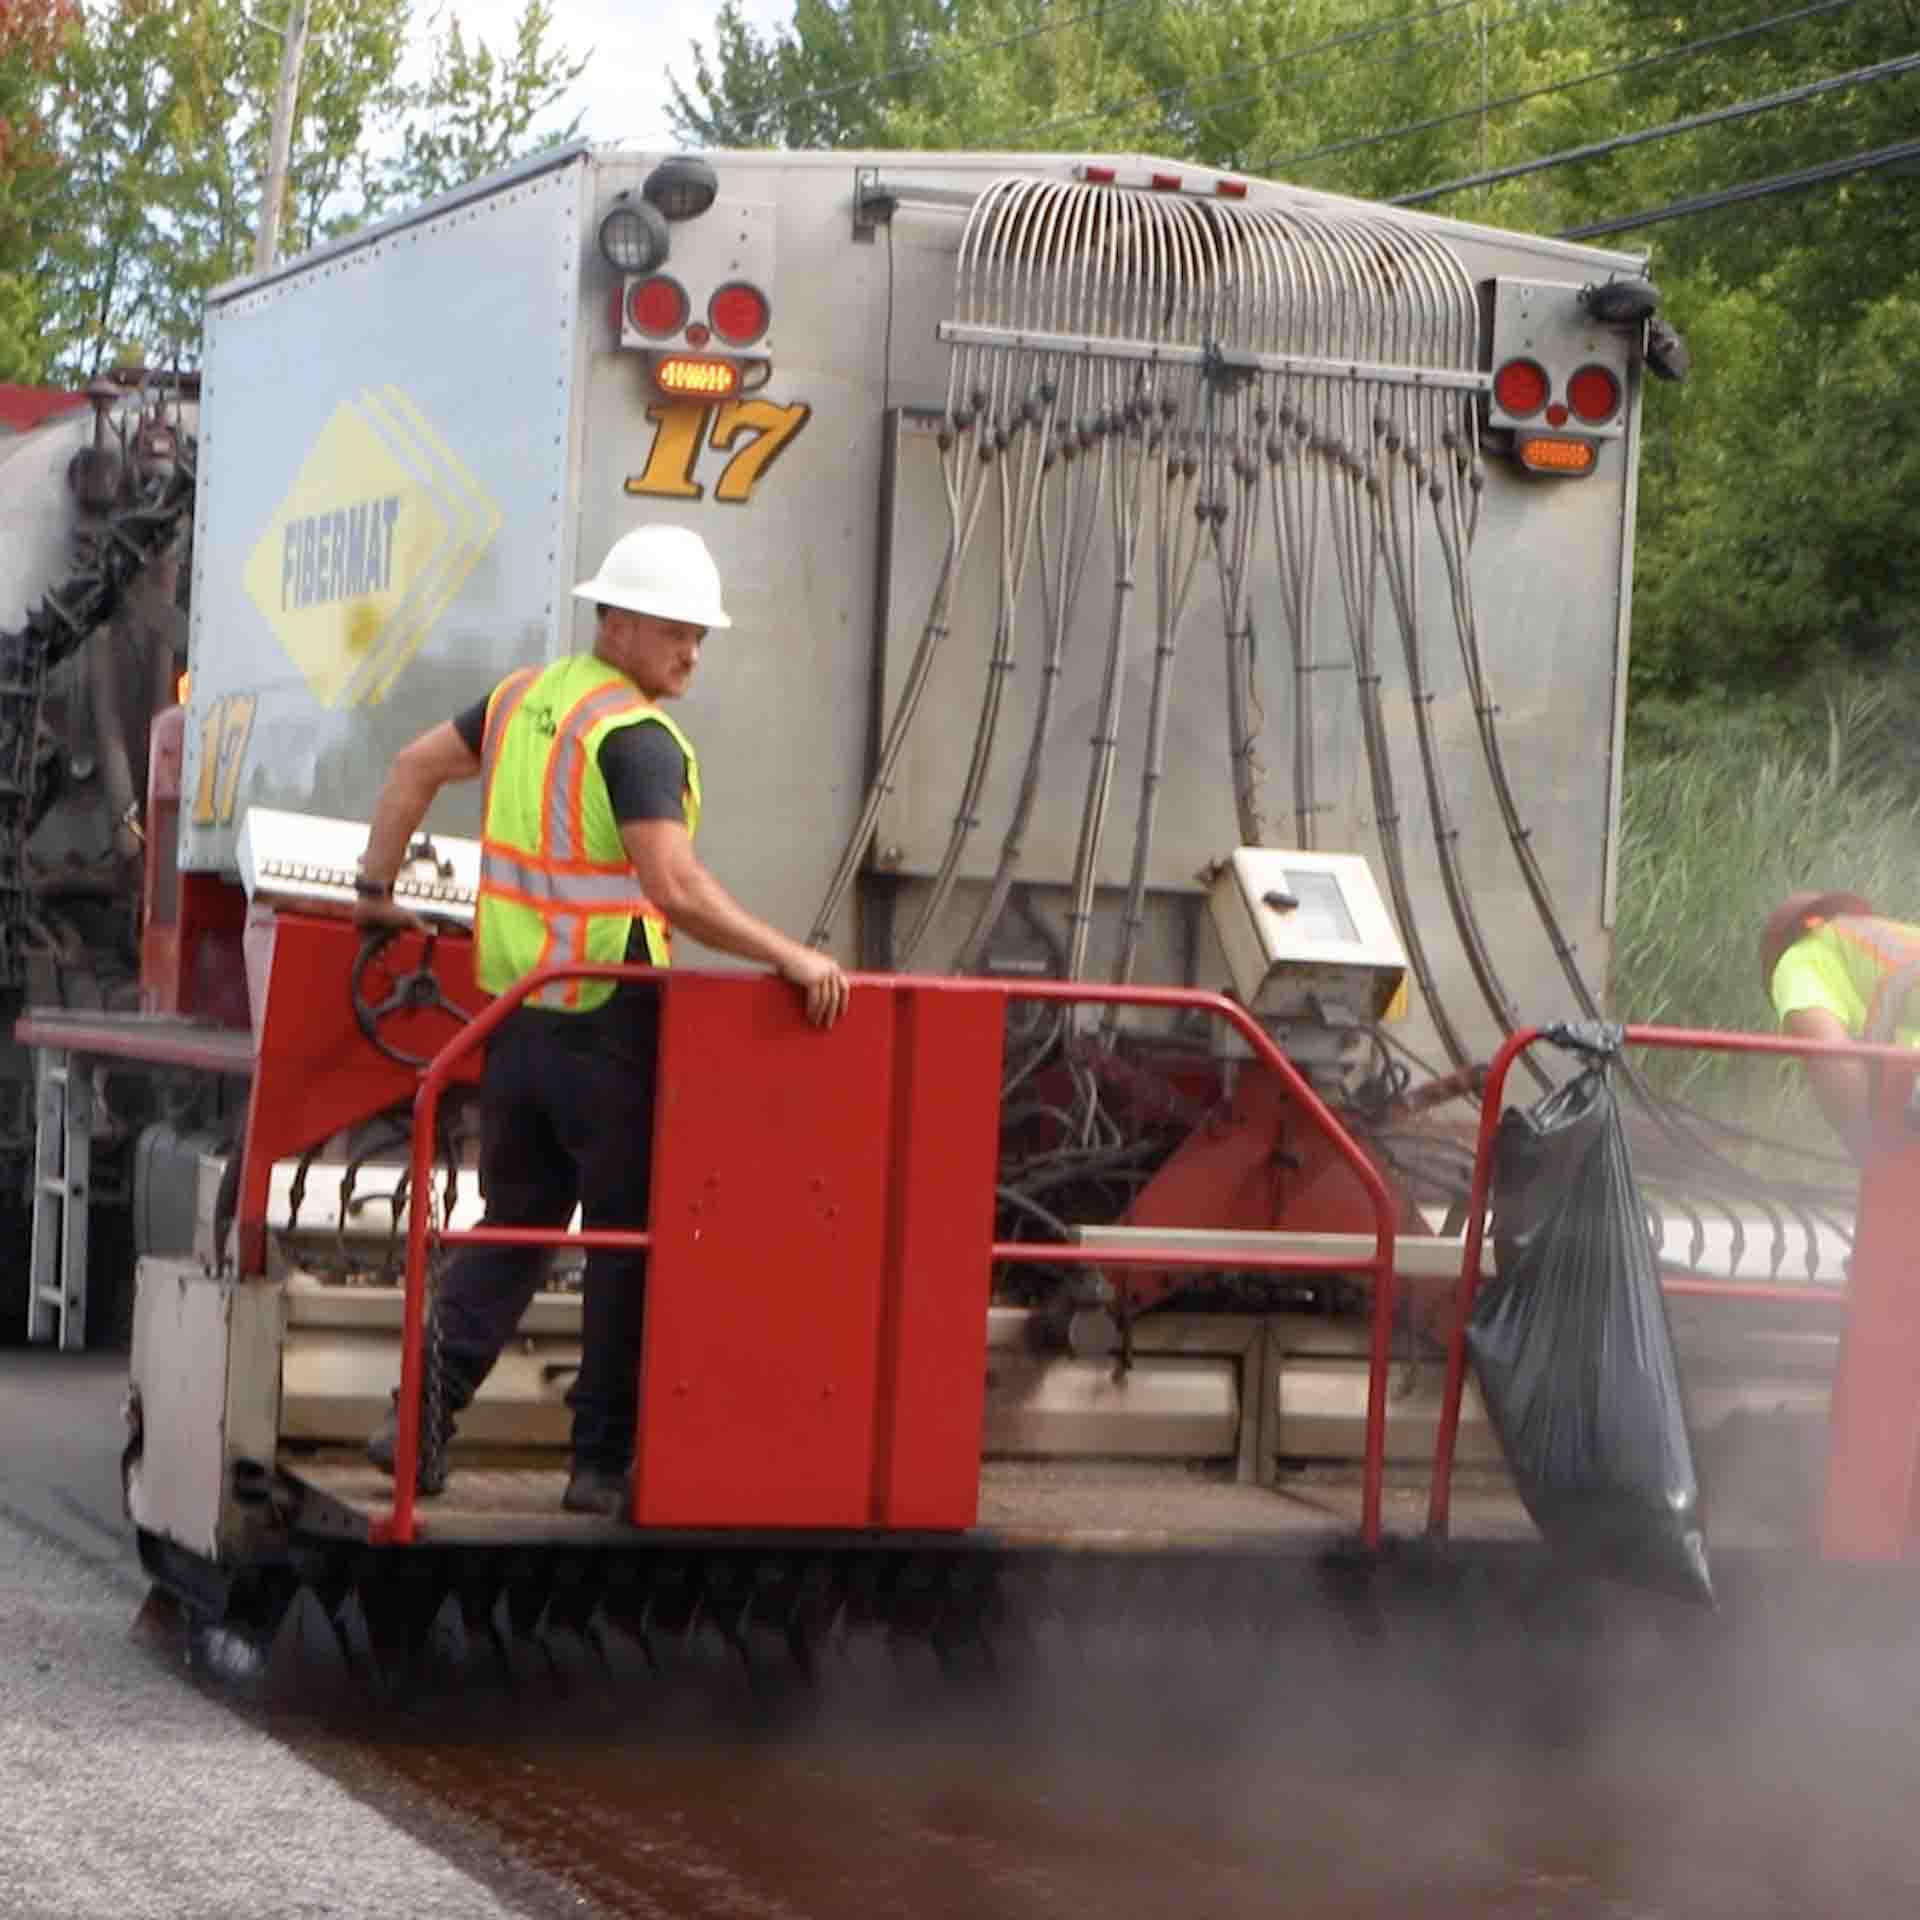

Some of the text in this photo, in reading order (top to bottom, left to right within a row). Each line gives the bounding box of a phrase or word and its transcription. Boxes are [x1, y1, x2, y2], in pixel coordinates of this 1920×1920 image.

[624, 398, 811, 503] 17
[281, 496, 401, 612] FIBERMAT
[192, 694, 257, 825] 17
